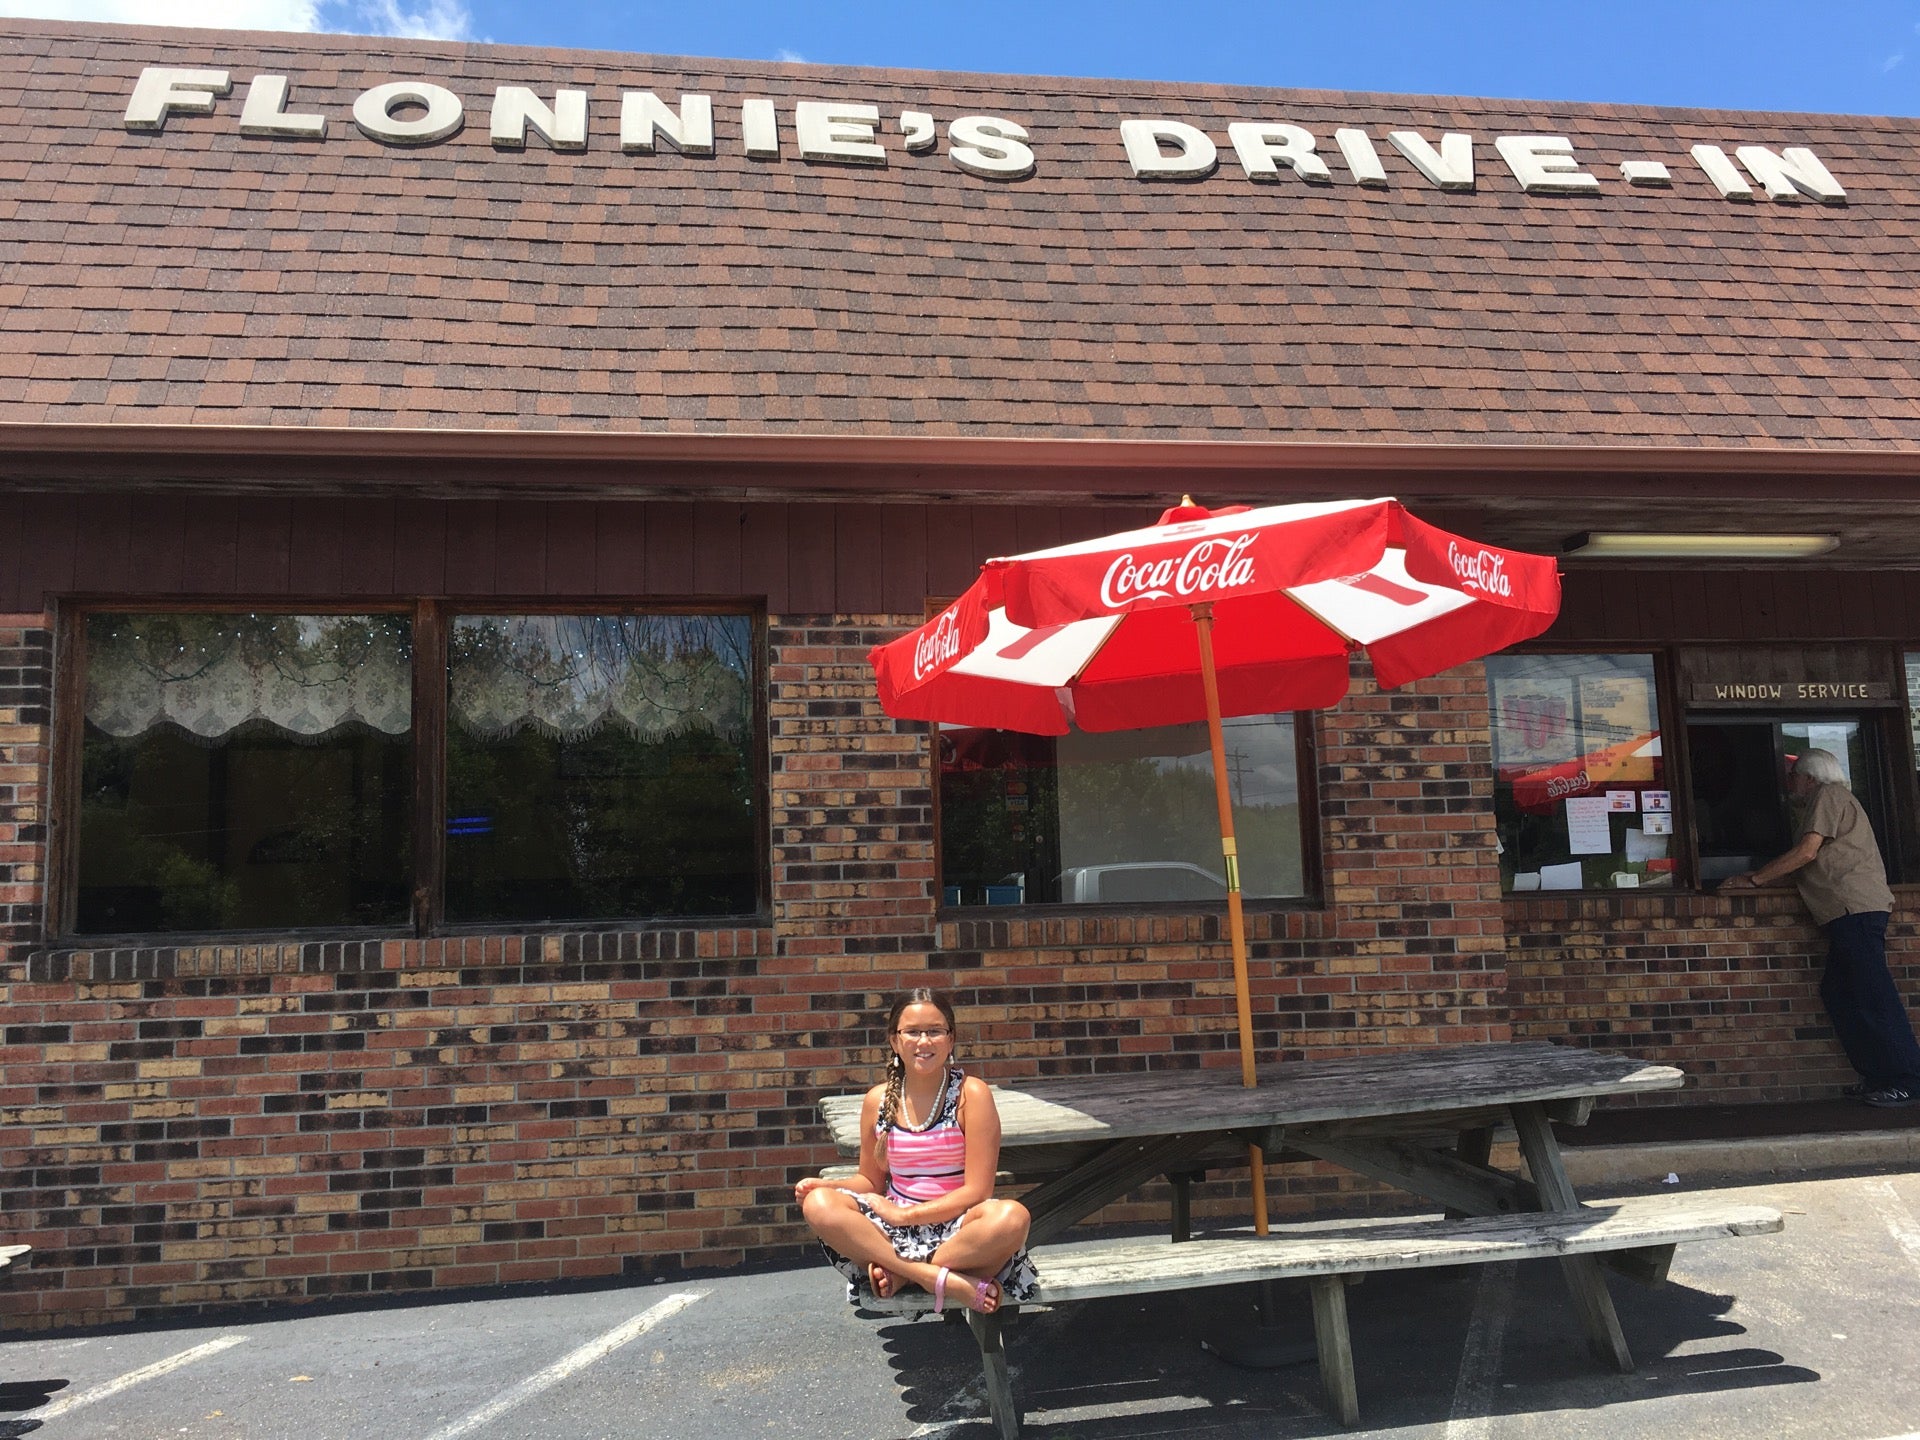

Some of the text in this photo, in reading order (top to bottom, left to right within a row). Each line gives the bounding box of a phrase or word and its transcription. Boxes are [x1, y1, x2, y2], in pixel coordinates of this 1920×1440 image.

[124, 67, 1035, 179] FLONNIE'S
[1101, 532, 1259, 608] Coca-Cola
[1448, 541, 1512, 597] Coca-Cola
[914, 606, 960, 681] Coca-Cola
[1715, 684, 1869, 699] WINDOW SERVICE
